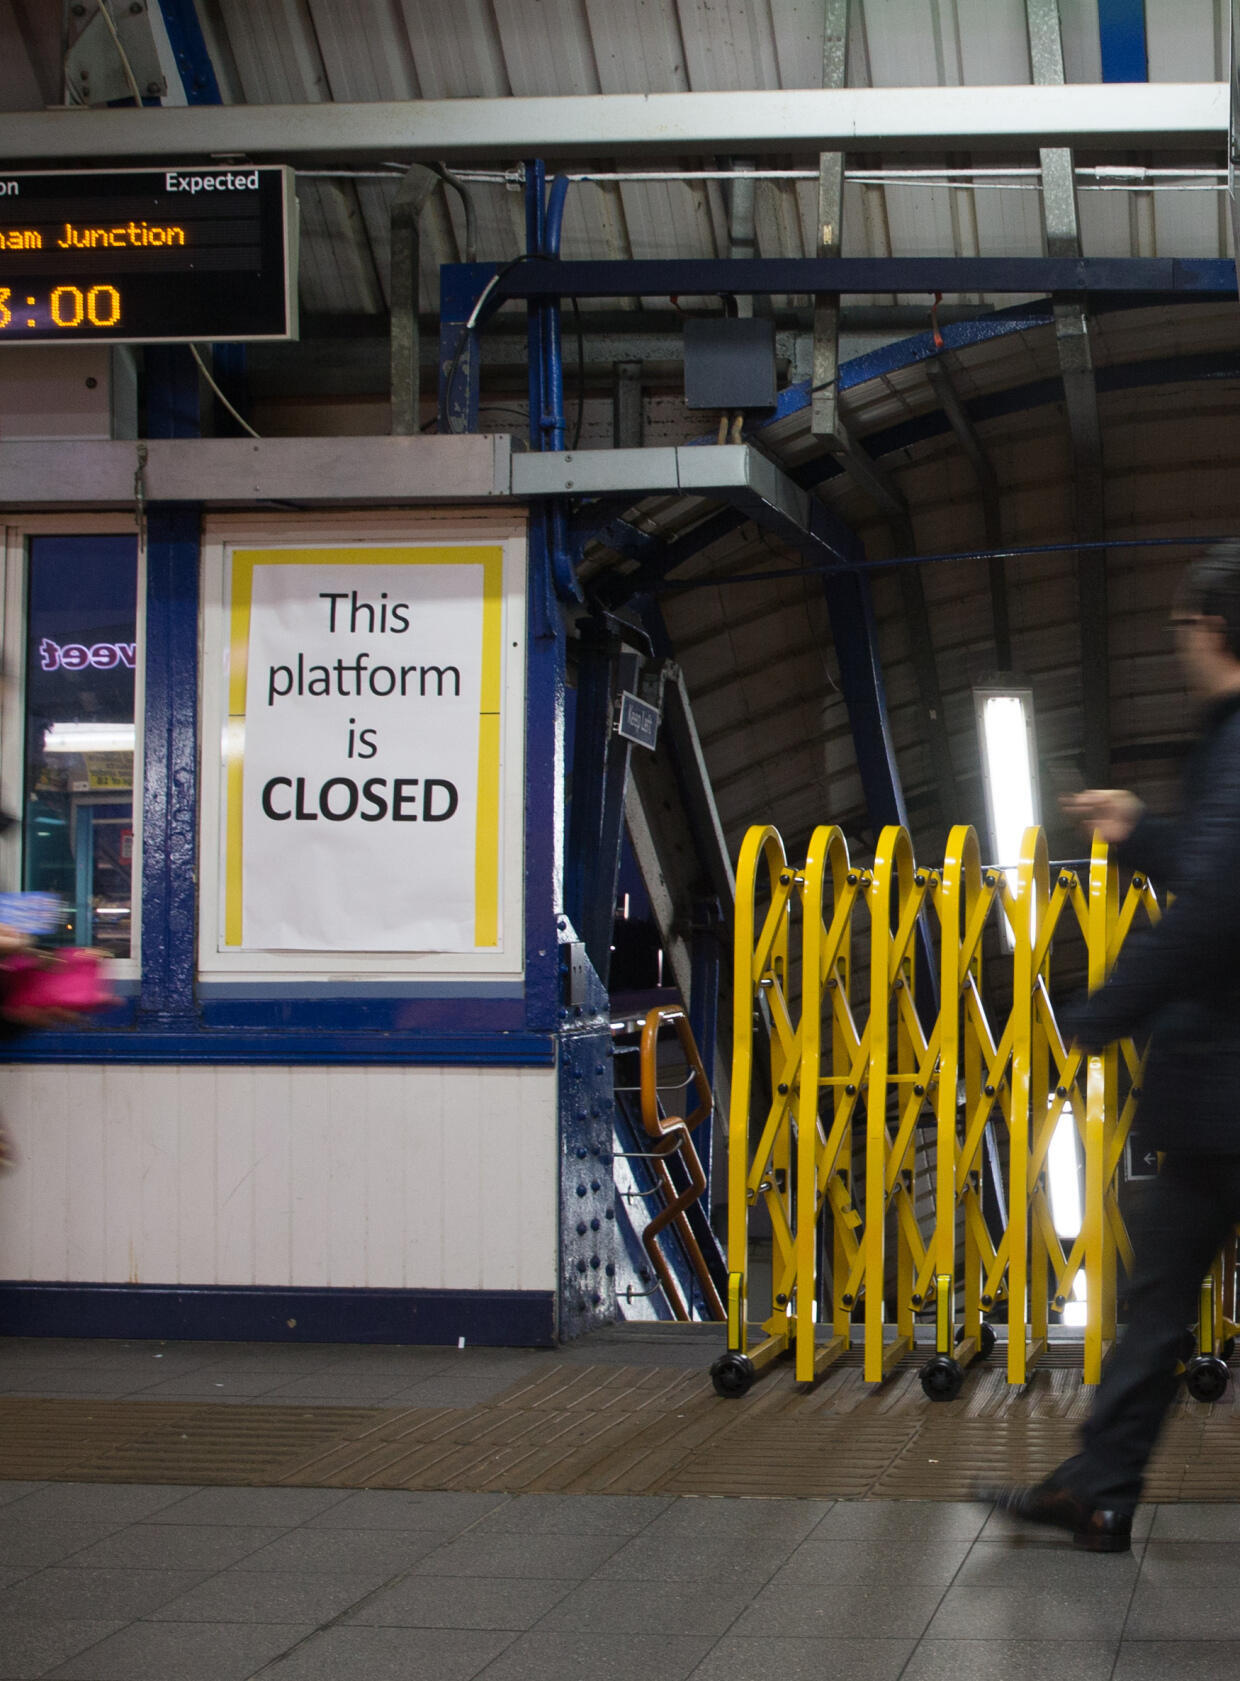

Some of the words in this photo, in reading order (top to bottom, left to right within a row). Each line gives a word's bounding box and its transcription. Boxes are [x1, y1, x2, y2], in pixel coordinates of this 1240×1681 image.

[165, 171, 260, 194] Expected
[58, 221, 185, 249] Junction
[319, 590, 410, 634] This
[268, 652, 460, 707] platform
[348, 717, 378, 759] is
[261, 776, 459, 822] CLOSED
